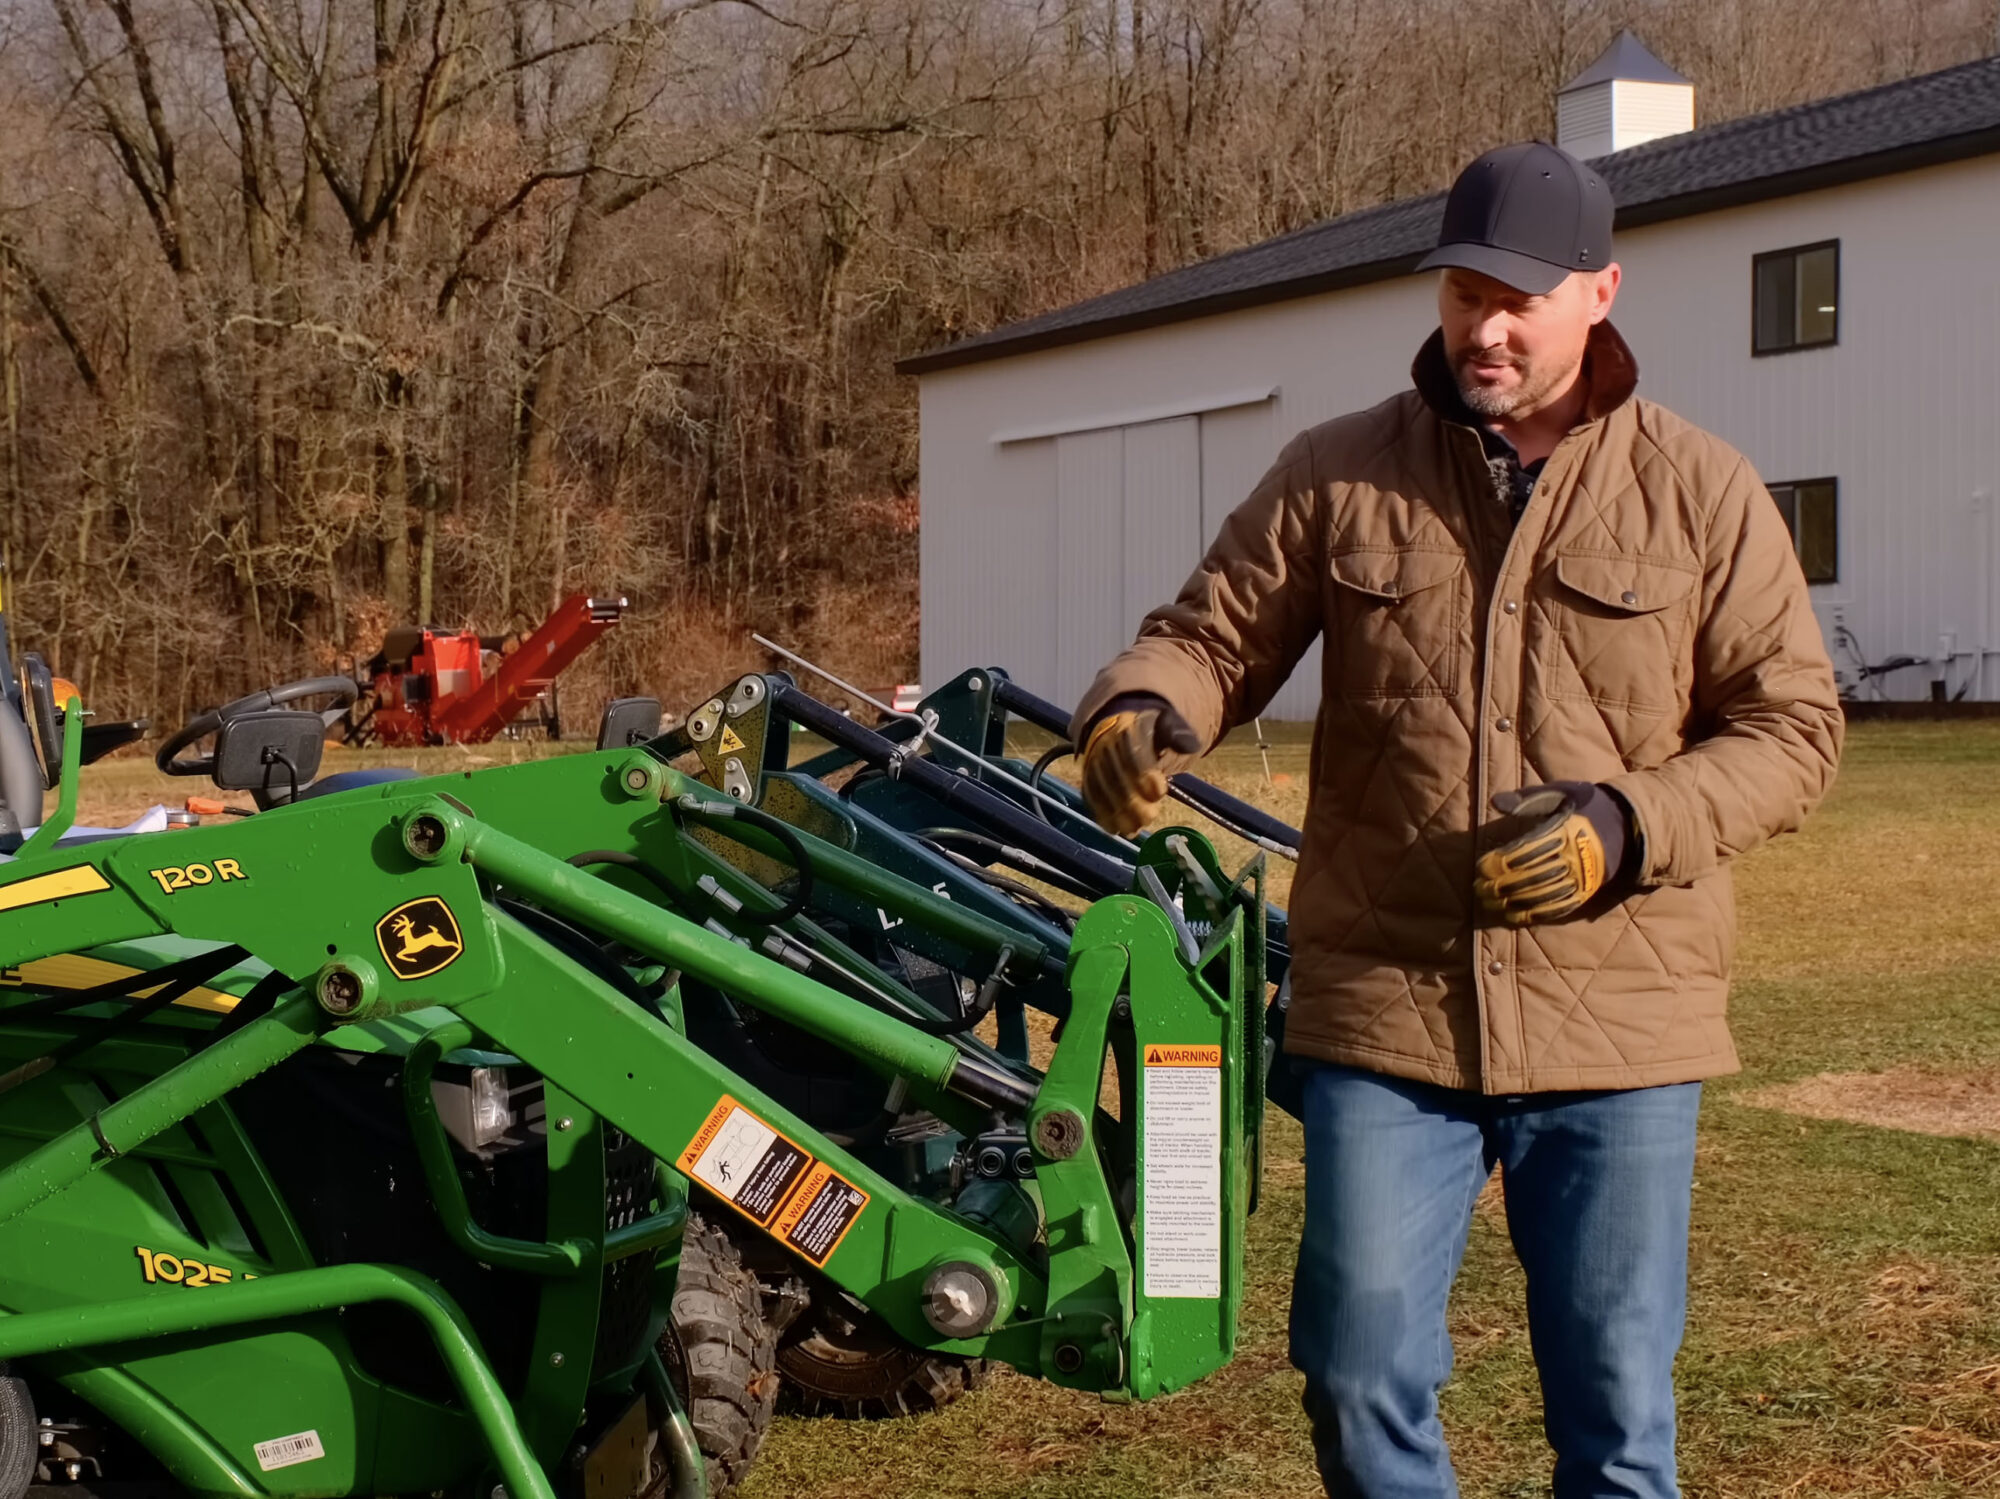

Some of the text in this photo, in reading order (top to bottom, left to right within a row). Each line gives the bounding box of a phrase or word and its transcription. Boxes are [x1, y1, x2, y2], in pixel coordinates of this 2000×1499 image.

[1163, 1050, 1218, 1063] WARNING
[693, 1105, 729, 1151] WARNING
[788, 1172, 825, 1219] WARNING
